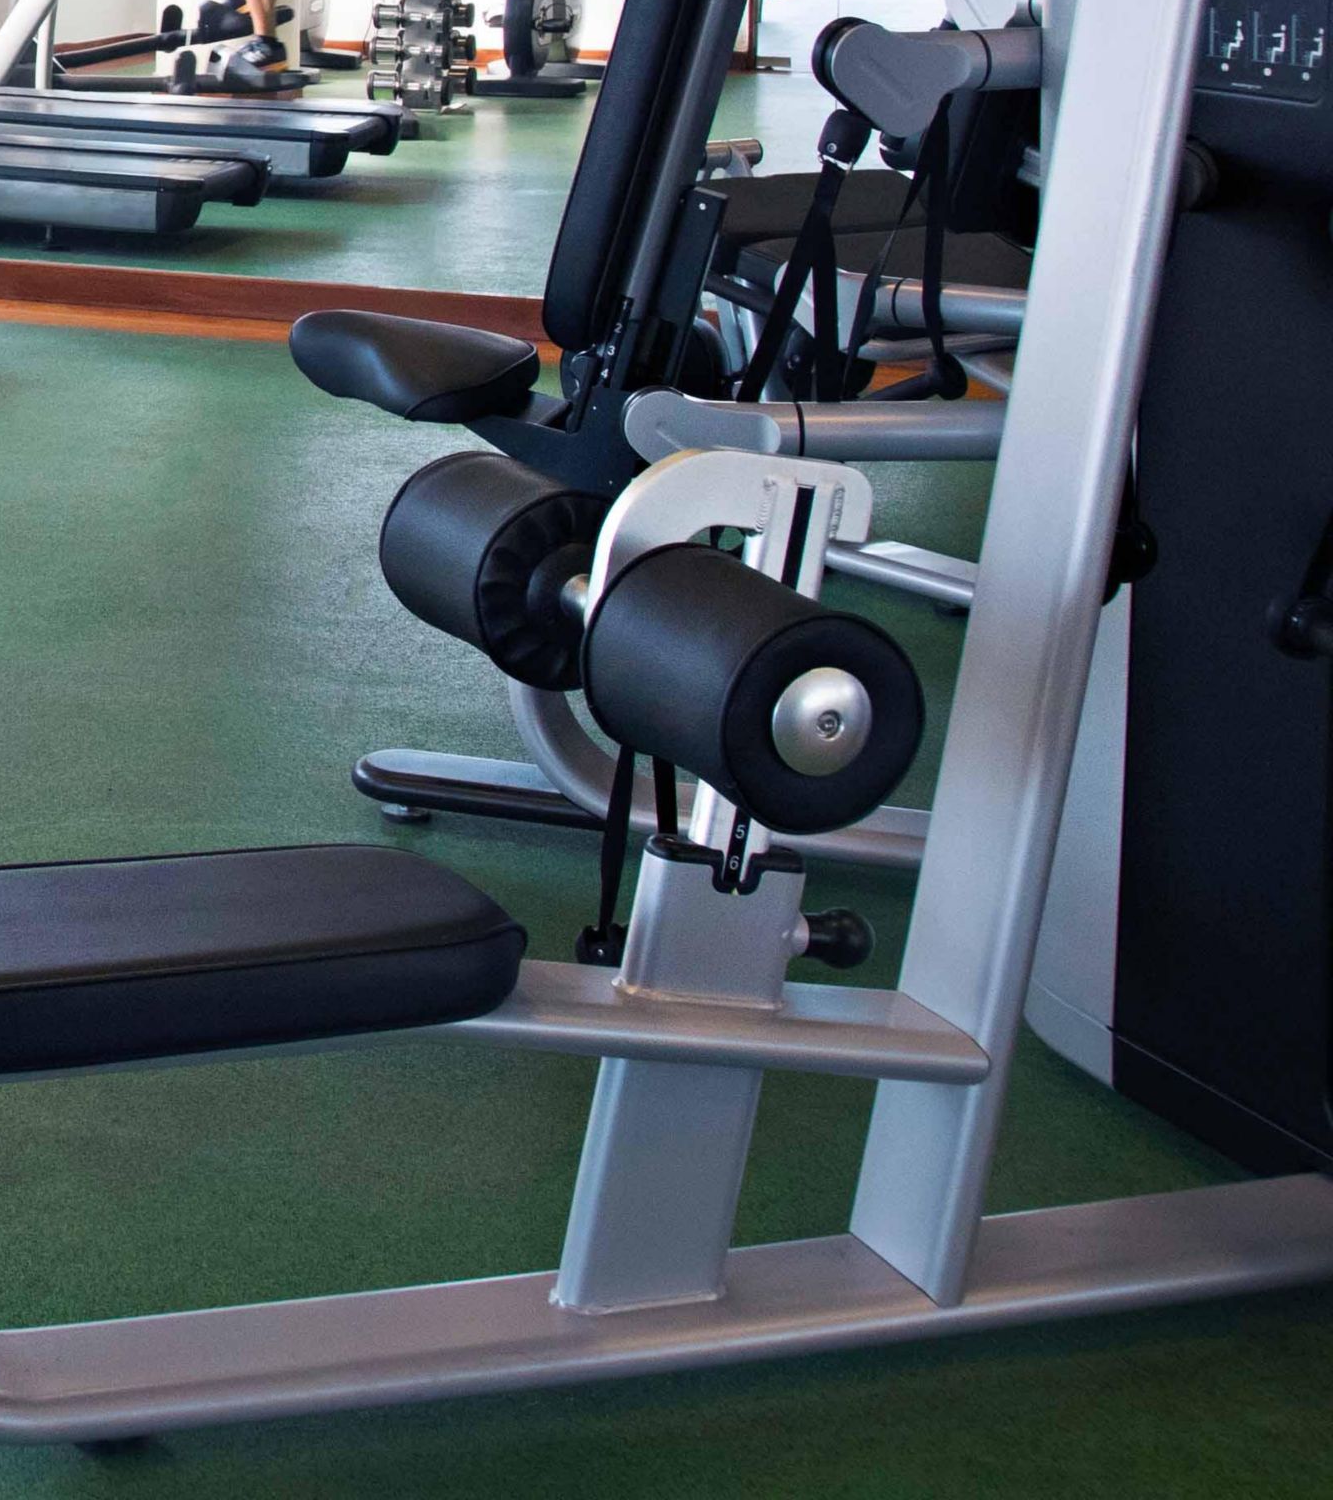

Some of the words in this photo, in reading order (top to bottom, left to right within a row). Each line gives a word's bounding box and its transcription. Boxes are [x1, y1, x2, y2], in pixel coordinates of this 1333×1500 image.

[614, 322, 623, 333] 2
[607, 345, 615, 356] 3
[601, 368, 609, 378] 4
[735, 825, 745, 839] 5
[729, 855, 740, 870] 6
